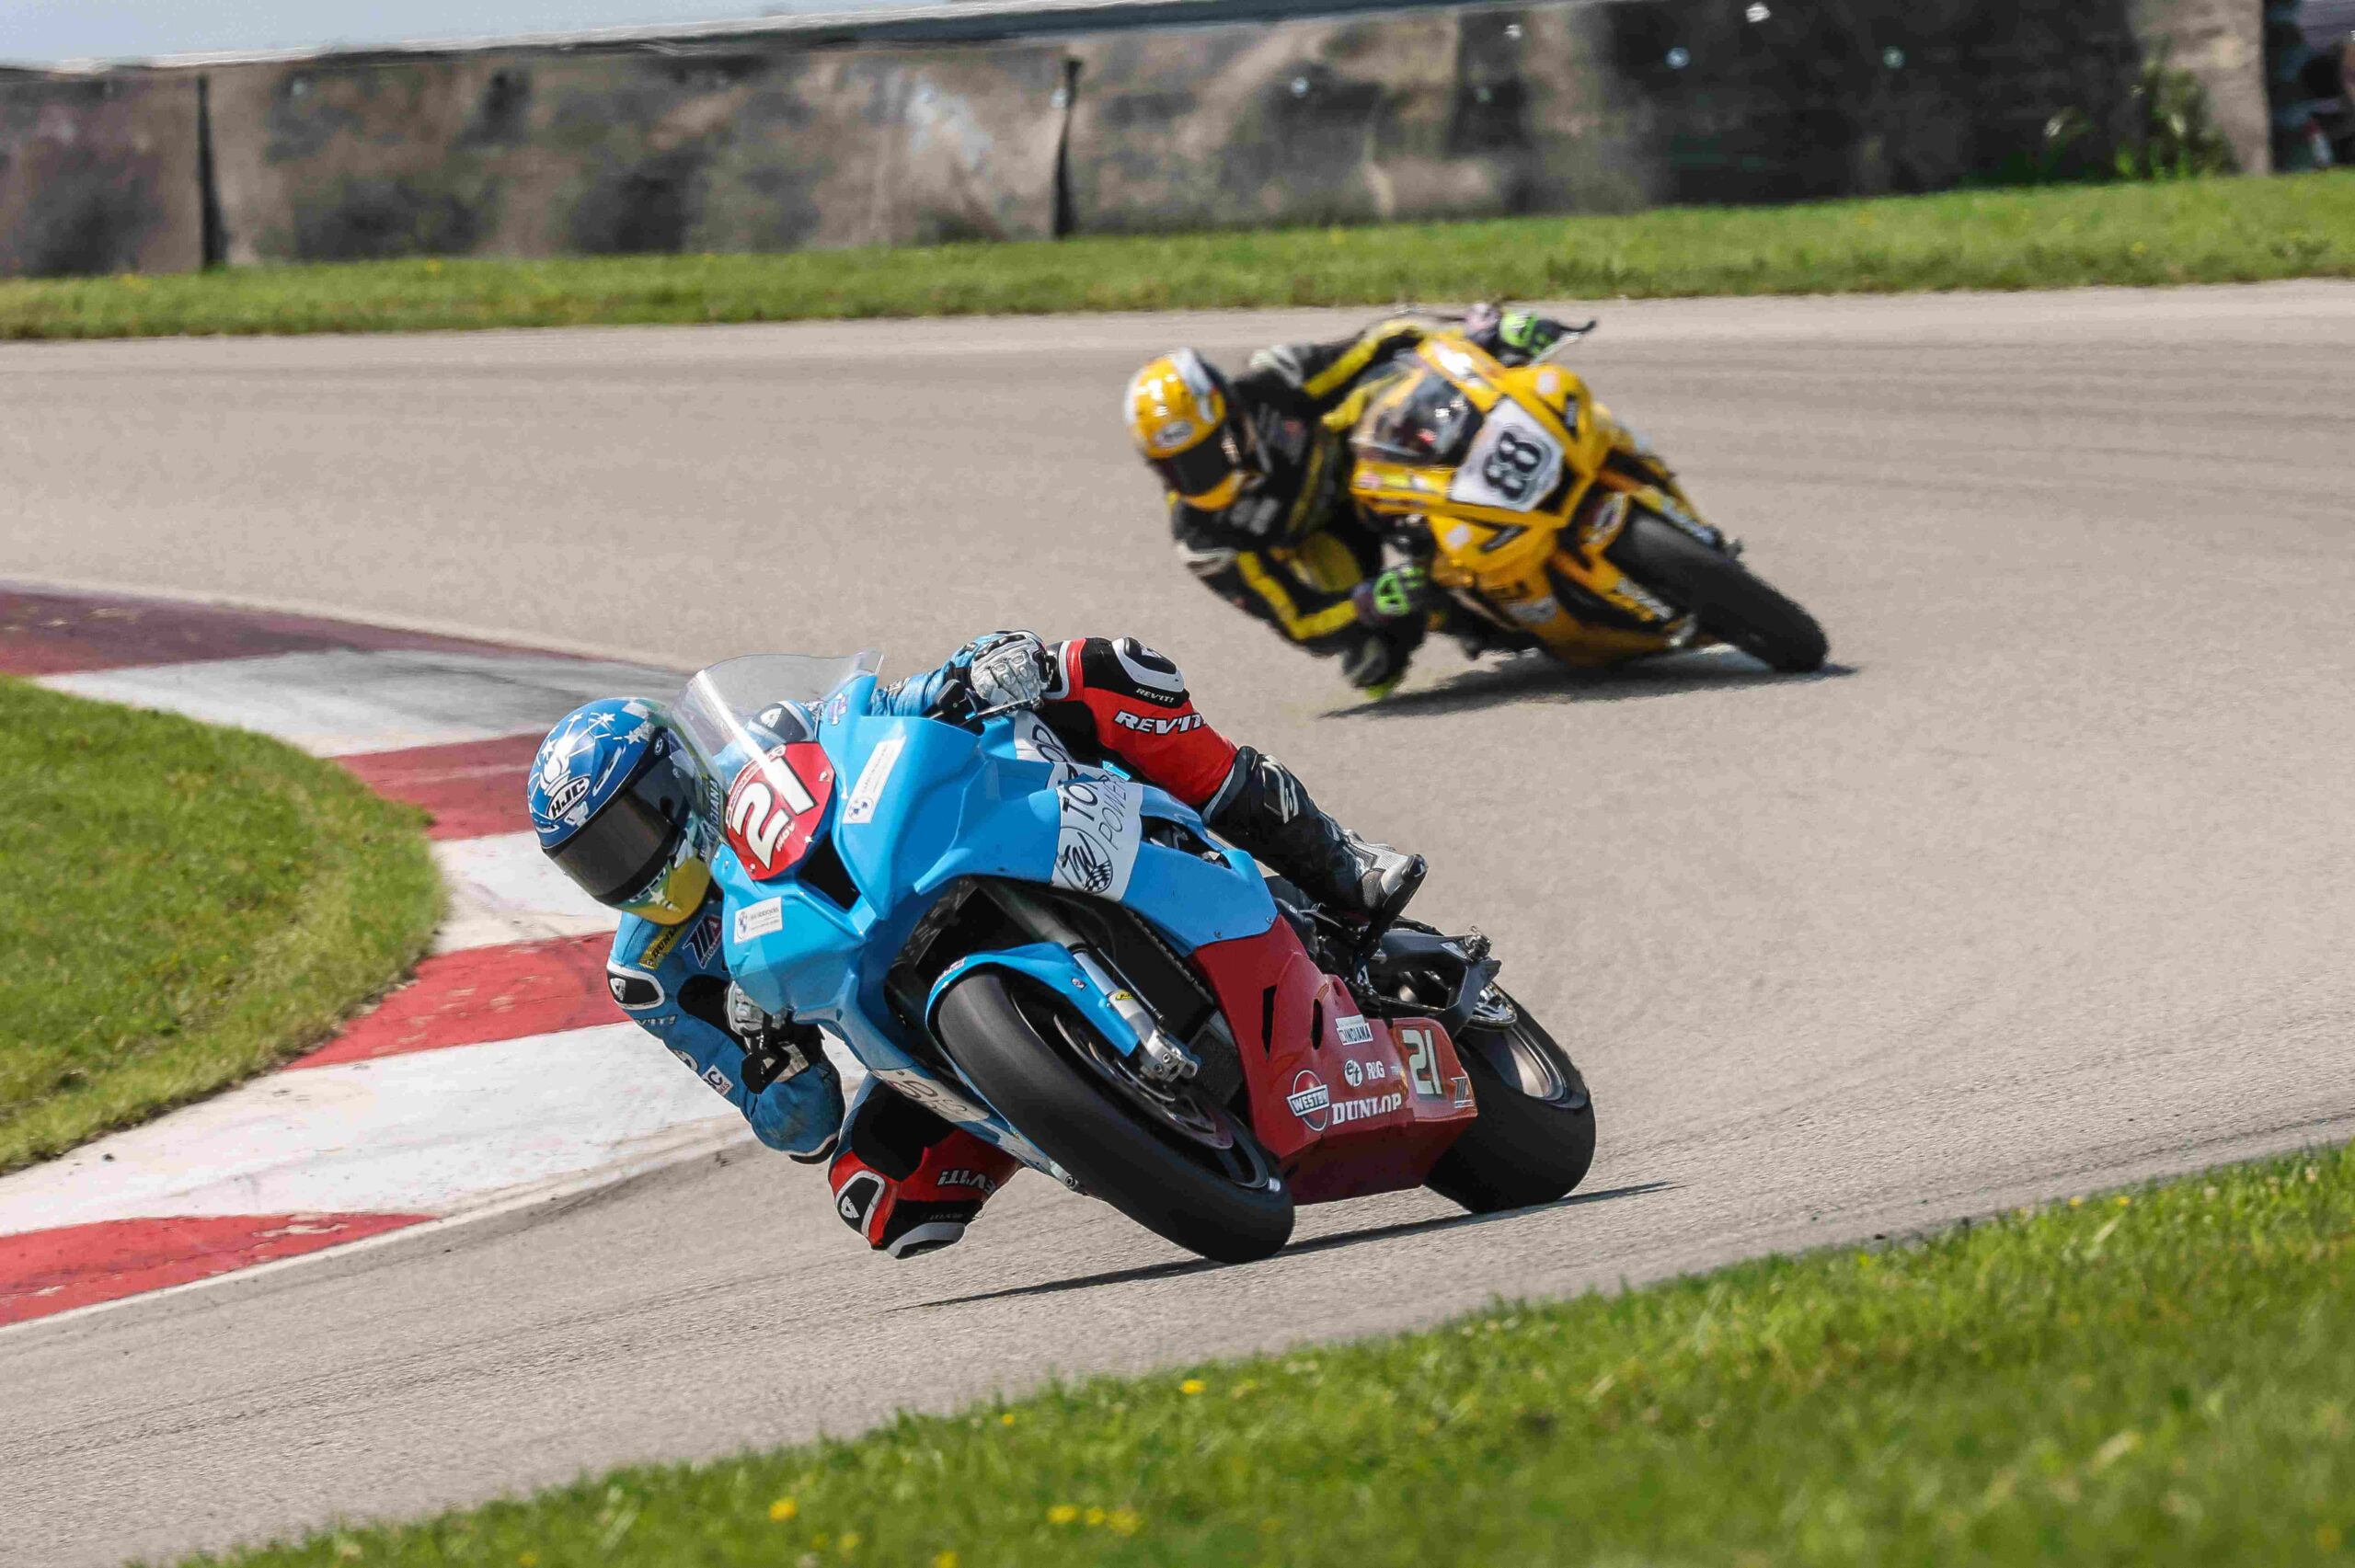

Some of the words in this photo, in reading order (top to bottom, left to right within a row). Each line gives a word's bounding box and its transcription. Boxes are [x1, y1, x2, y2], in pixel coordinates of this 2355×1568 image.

[1482, 429, 1542, 501] 88
[1135, 688, 1175, 704] REV'IT!
[1114, 711, 1207, 735] REV'IT
[551, 779, 586, 818] HJC
[731, 757, 819, 871] 21
[1401, 1029, 1443, 1095] 21
[1331, 1093, 1402, 1125] DUNLOP
